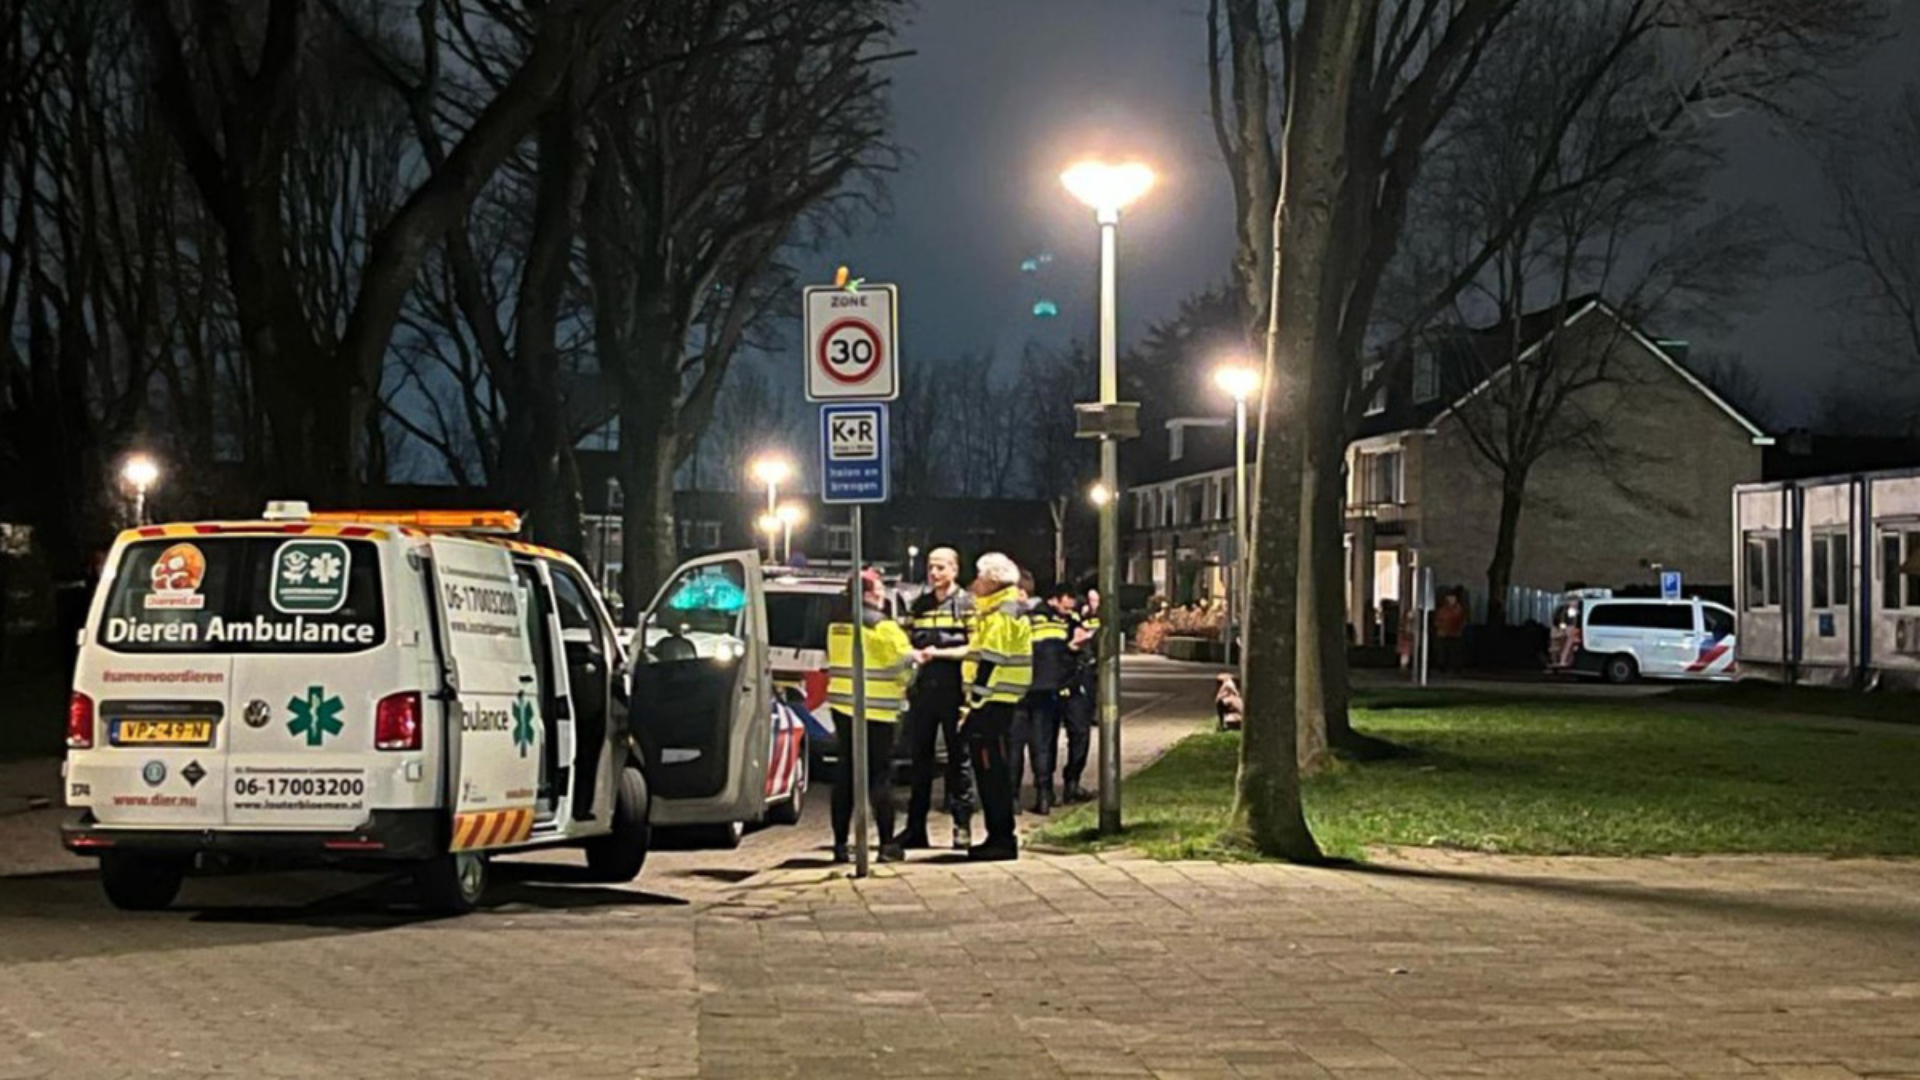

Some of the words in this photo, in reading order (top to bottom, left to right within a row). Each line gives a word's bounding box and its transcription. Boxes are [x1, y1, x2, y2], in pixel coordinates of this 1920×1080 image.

[831, 295, 868, 307] ZONE
[831, 339, 872, 365] 30
[832, 421, 873, 442] K+R
[864, 468, 878, 477] en
[831, 483, 878, 493] brengen
[107, 617, 197, 643] Dieren
[205, 616, 374, 643] Ambulance
[103, 670, 224, 683] #samenvoordieren
[127, 722, 204, 738] VPZ-49-N
[234, 778, 363, 796] 06-17003200
[113, 793, 198, 807] www.dier.nu
